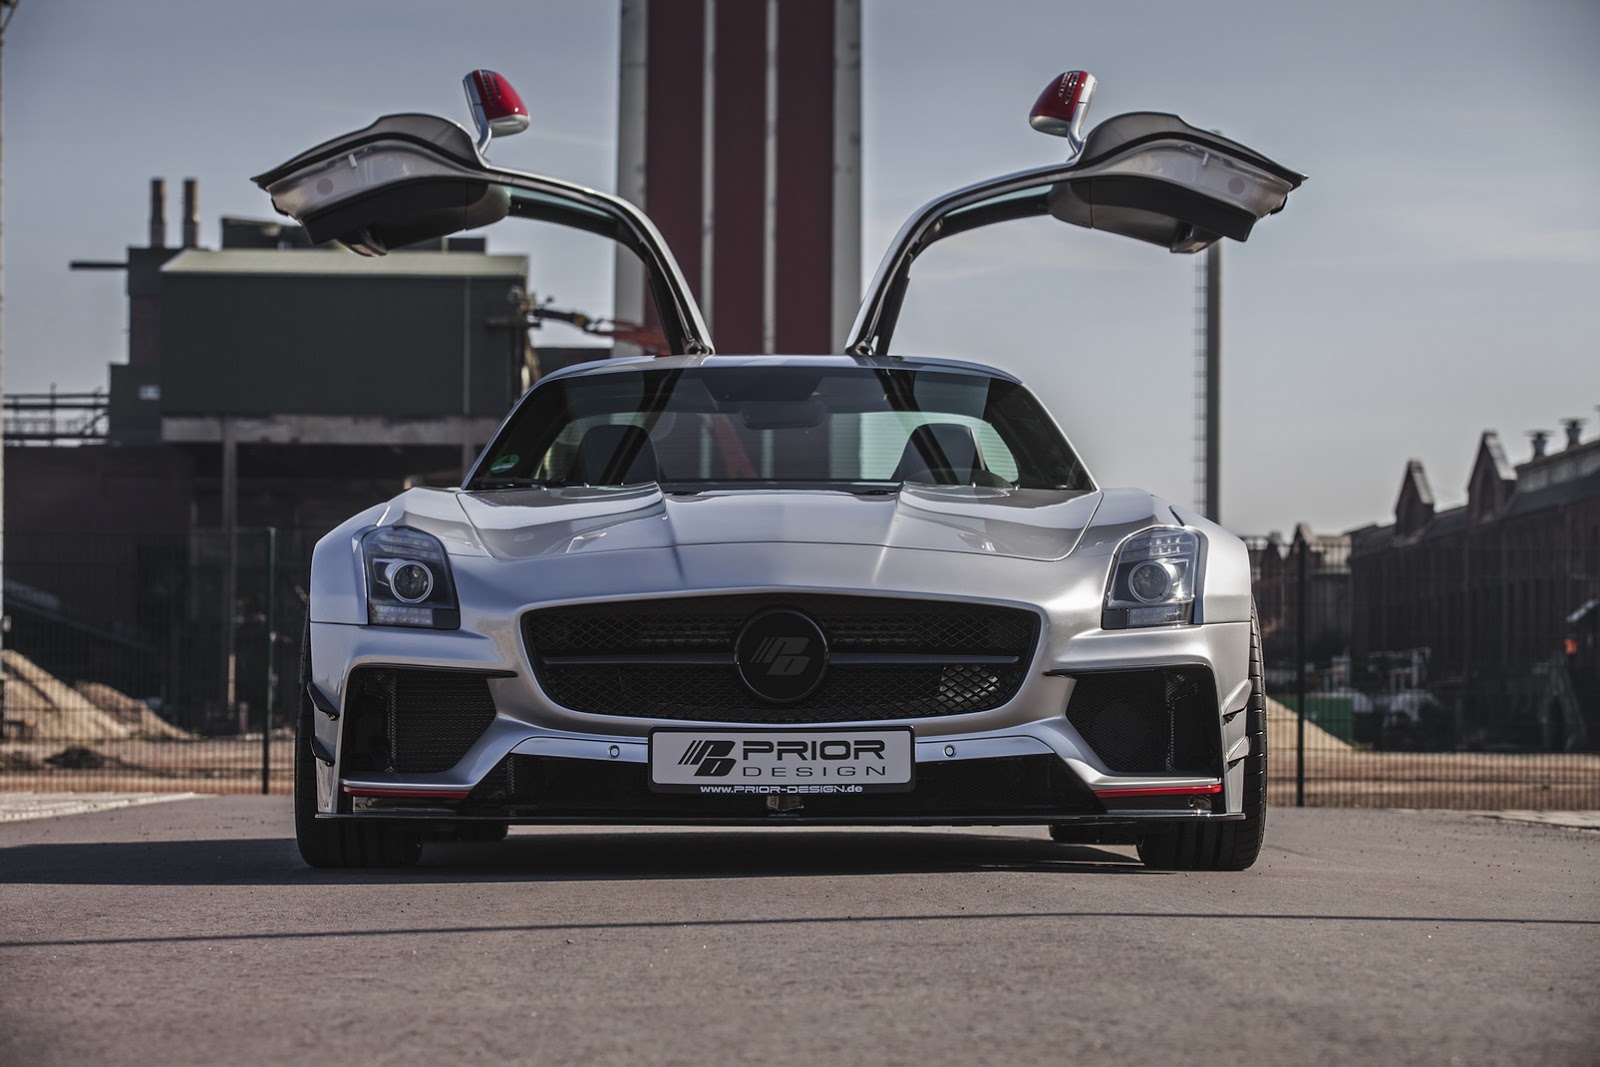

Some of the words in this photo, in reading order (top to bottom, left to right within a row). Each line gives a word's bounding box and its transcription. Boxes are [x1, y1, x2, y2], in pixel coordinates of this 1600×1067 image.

[742, 739, 886, 761] PRIOR
[742, 765, 886, 778] DESIGN
[700, 784, 863, 794] www.PRIOR-DESIGN.de
